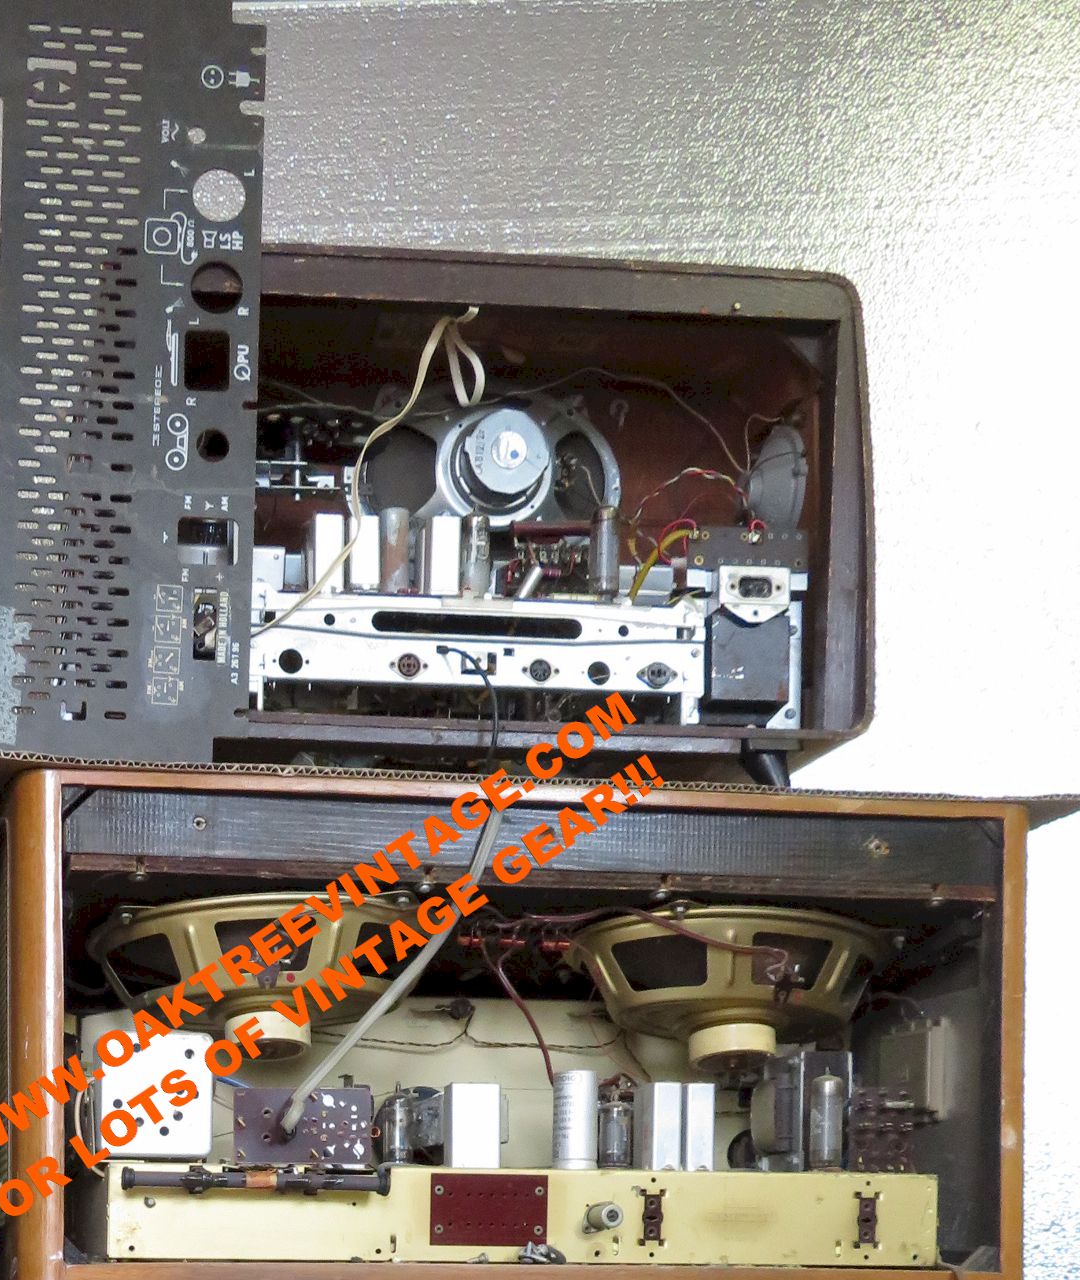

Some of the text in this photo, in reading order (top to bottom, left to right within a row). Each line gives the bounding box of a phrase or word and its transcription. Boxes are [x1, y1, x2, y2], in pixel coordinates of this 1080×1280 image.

[219, 233, 231, 249] LS
[232, 230, 244, 251] HP
[237, 306, 249, 316] R
[237, 344, 250, 364] PU
[153, 379, 162, 432] STEREO
[187, 396, 197, 406] R
[184, 496, 193, 510] FM
[221, 496, 229, 511] AM
[182, 568, 189, 583] FM
[217, 591, 229, 664] MADE IN HOLLAND
[230, 673, 239, 685] A3
